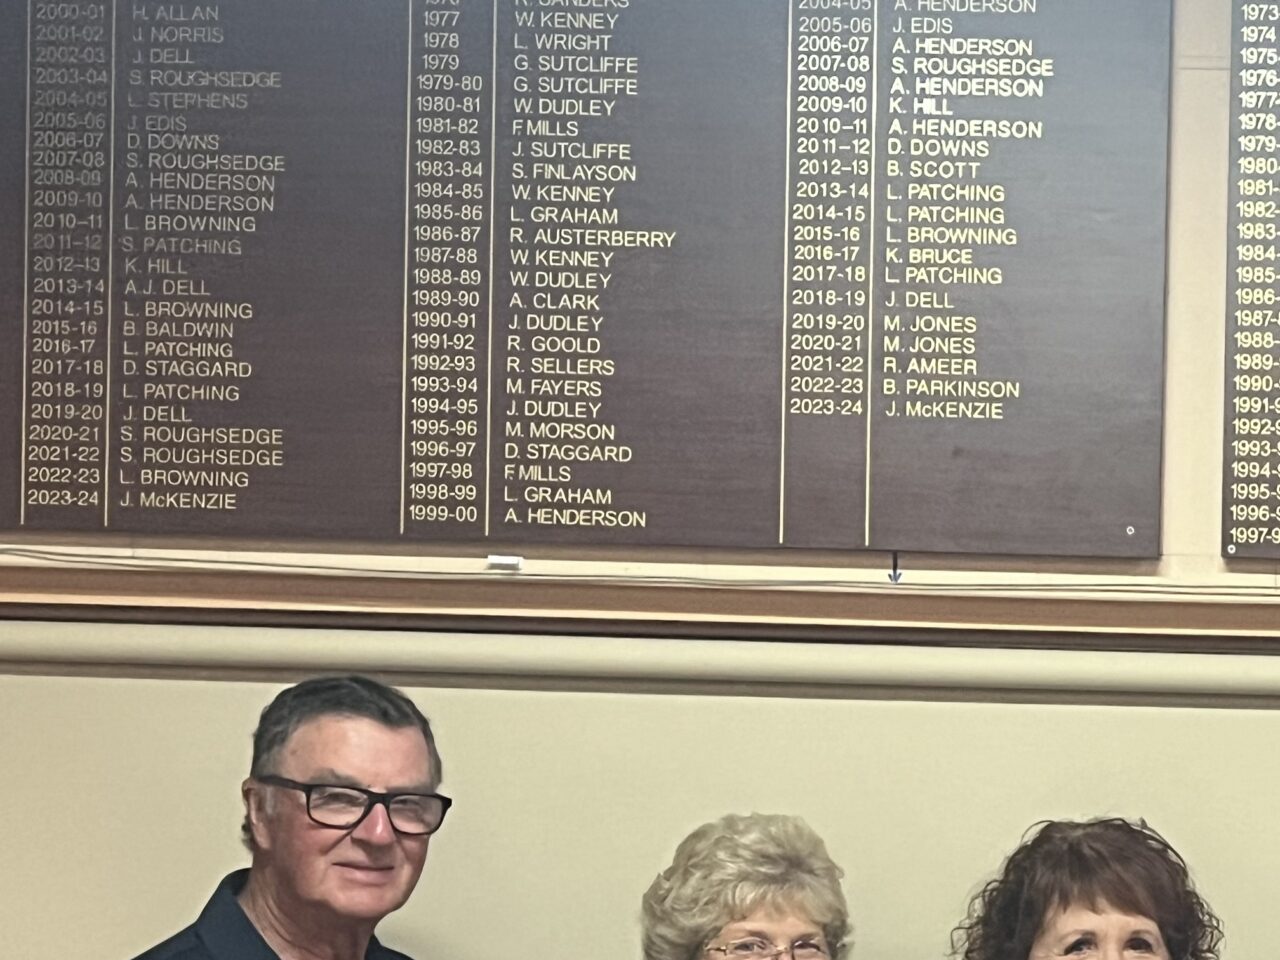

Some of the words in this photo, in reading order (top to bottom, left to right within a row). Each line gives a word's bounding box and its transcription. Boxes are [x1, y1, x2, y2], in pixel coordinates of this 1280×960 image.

[424, 10, 461, 27] 1977
[540, 11, 620, 30] KENNEY
[423, 31, 460, 49] 1978
[534, 33, 613, 52] WRIGHT
[797, 34, 870, 53] 2006-07
[915, 37, 1033, 57] HENDERSON
[797, 53, 870, 73] 2007-08
[913, 56, 1055, 77] ROUGHSEDGE
[415, 160, 483, 178] 1983-84
[533, 162, 637, 182] FINLAYSON
[33, 189, 103, 208] 2009-10
[150, 192, 275, 212] HENDERSON
[796, 180, 869, 199] 2013-14
[907, 183, 1005, 203] PATCHING
[413, 224, 482, 243] 1986-87
[533, 228, 677, 248] AUSTERBERRY
[414, 246, 478, 264] 1987-88
[535, 249, 615, 268] KENNEY
[794, 244, 860, 262] 2016-17
[908, 248, 973, 265] BRUCE
[31, 298, 104, 316] 2014-15
[145, 301, 253, 320] BROWNING
[791, 312, 865, 332] 2019-20
[909, 315, 977, 334] JONES
[411, 332, 475, 351] 1991-92
[531, 335, 601, 354] GOOLD
[31, 358, 104, 376] 2017-18
[145, 359, 252, 378] STAGGARD
[790, 354, 864, 373] 2021-22
[906, 357, 977, 376] AMEER
[31, 380, 104, 398] 2018-19
[143, 382, 240, 402] PATCHING
[790, 376, 864, 394] 2022-23
[906, 378, 1020, 398] PARKINSON
[790, 397, 863, 416] 2023-24
[905, 400, 1004, 420] McKENZIE
[28, 424, 99, 442] 2020-21
[143, 426, 284, 445] ROUGHSEDGE
[410, 418, 478, 437] 1995-96
[529, 421, 615, 441] MORSON
[27, 488, 99, 506] 2023-24
[139, 491, 237, 510] McKENZIE
[409, 504, 478, 522] 1999-00
[527, 507, 647, 528] HENDERSON
